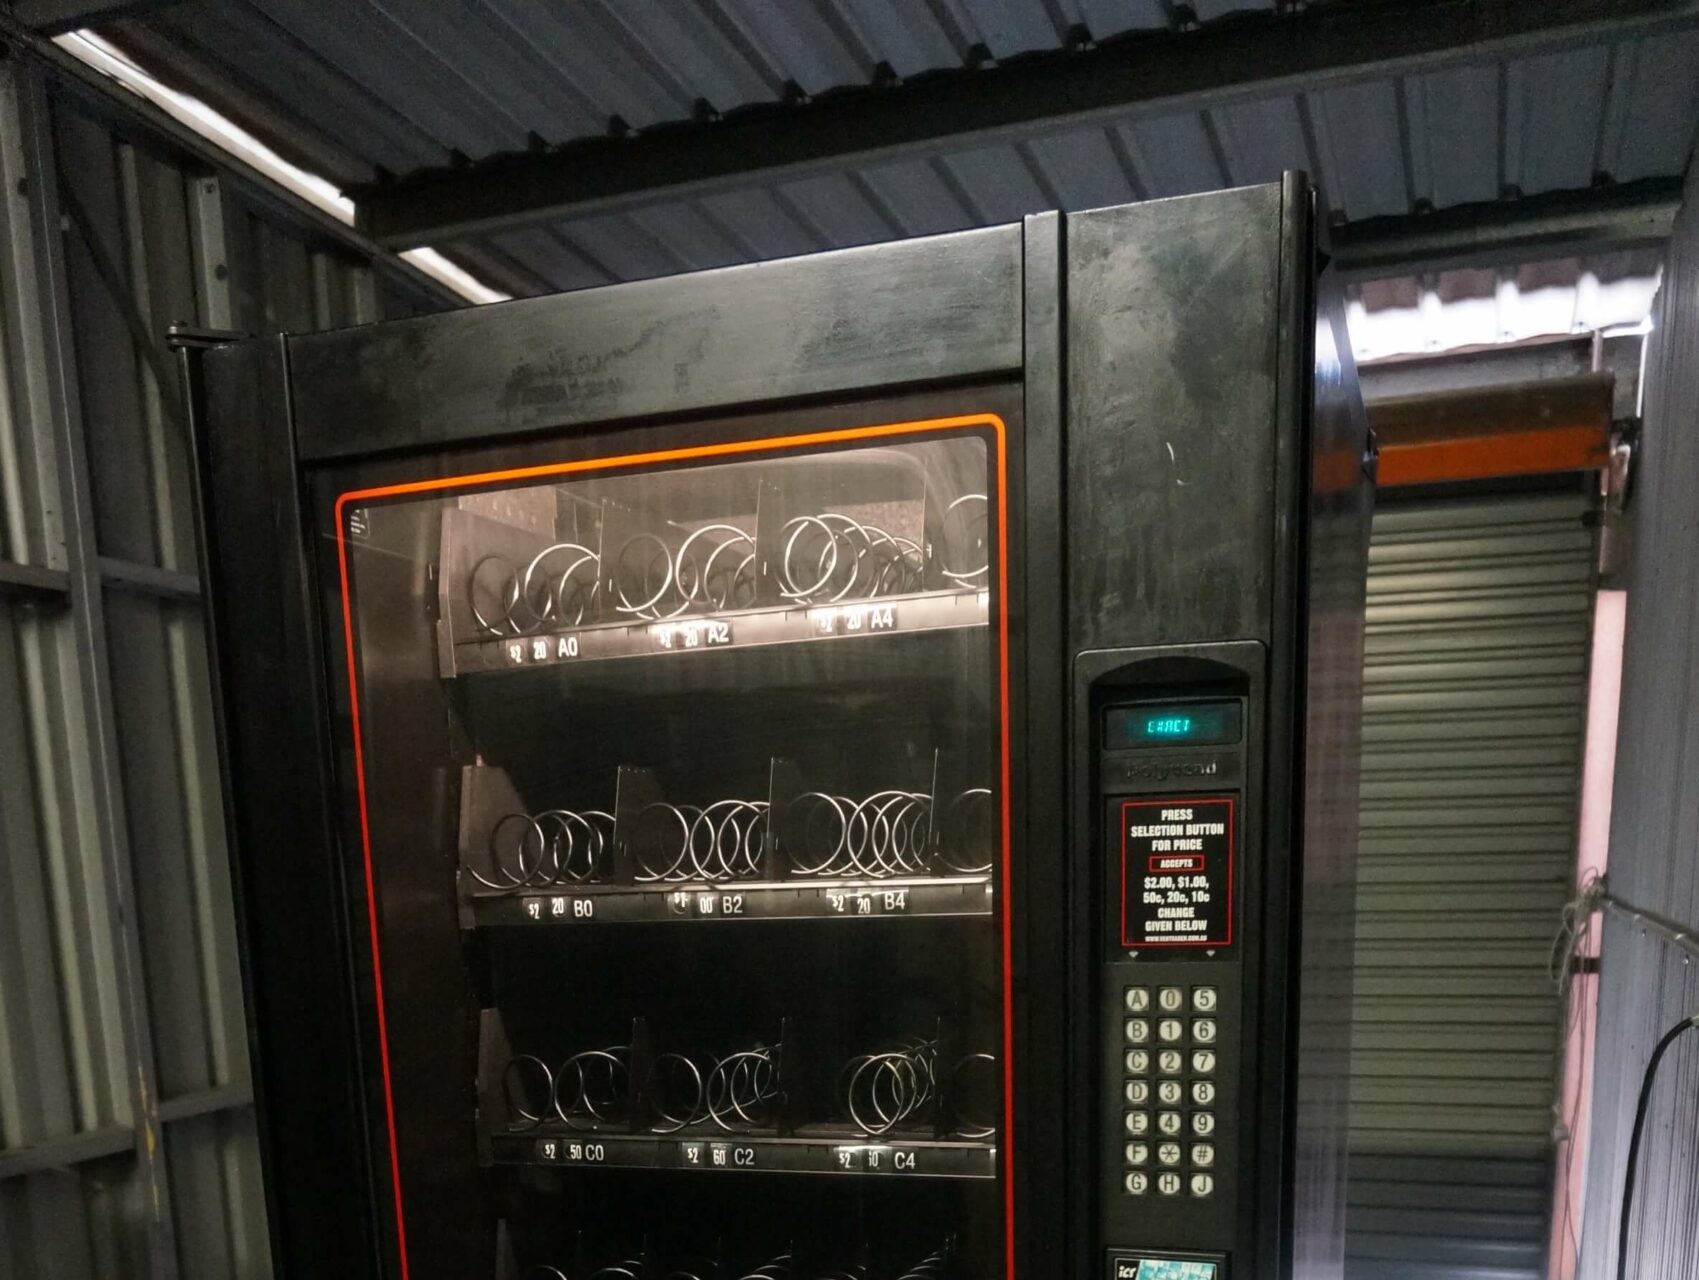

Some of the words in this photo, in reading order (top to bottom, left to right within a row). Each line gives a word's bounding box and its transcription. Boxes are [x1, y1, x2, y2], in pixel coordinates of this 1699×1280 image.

[872, 609, 893, 629] A4
[709, 623, 729, 643] A2
[559, 637, 578, 657] A0
[1161, 809, 1192, 820] PRESS
[1131, 824, 1183, 837] SELECTION
[1186, 823, 1224, 835] BUTTON
[1152, 840, 1172, 851] FOR
[1174, 839, 1202, 850] PRICE
[1160, 859, 1193, 868] ACCEPTS
[529, 904, 540, 919] $2
[552, 898, 564, 914] 20
[574, 900, 593, 917] B0
[700, 897, 712, 913] 00
[723, 896, 743, 913] B2
[832, 895, 844, 911] $2
[857, 898, 870, 914] 20
[885, 892, 905, 910] B4
[1158, 907, 1194, 919] CHANGE
[1145, 921, 1173, 932] GIVEN
[1174, 920, 1207, 931] BELOW
[1132, 991, 1142, 1006] A
[1166, 991, 1175, 1006] 0
[1200, 991, 1209, 1006] 5
[1133, 1023, 1142, 1038] B
[1166, 1023, 1173, 1037] 1
[1200, 1023, 1209, 1038] 6
[1132, 1055, 1142, 1069] C
[1165, 1055, 1174, 1069] 2
[1200, 1055, 1208, 1069] 7
[1132, 1085, 1142, 1099] D
[1165, 1085, 1174, 1099] 3
[1199, 1086, 1208, 1099] 8
[1133, 1116, 1141, 1129] E
[1165, 1116, 1174, 1129] 4
[1199, 1116, 1208, 1130] 9
[545, 1144, 555, 1159] $2
[571, 1144, 582, 1159] 50
[586, 1144, 604, 1161] C0
[688, 1148, 698, 1163] $2
[713, 1150, 725, 1165] 60
[735, 1148, 754, 1165] C2
[1133, 1147, 1141, 1160] F
[840, 1152, 850, 1168] $2
[895, 1152, 916, 1169] C4
[1132, 1176, 1141, 1190] G
[1165, 1177, 1174, 1190] H
[1198, 1178, 1207, 1192] J
